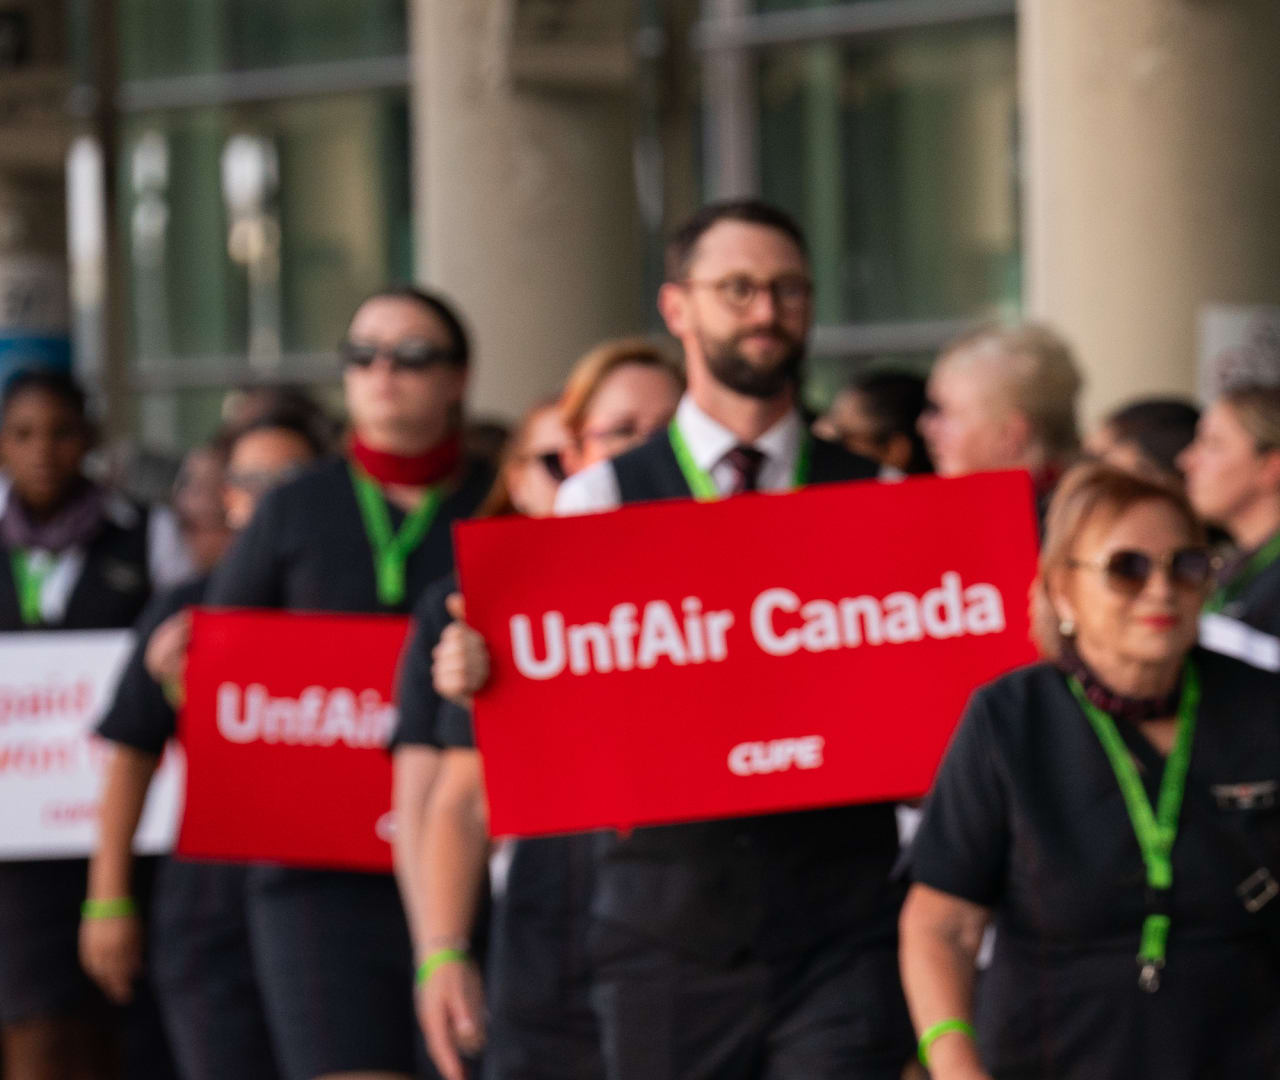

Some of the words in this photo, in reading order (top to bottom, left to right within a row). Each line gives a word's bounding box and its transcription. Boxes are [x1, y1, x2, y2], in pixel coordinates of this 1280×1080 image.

[511, 597, 733, 679] UnfAir
[752, 572, 1004, 655] Canada
[217, 681, 396, 748] UnfAir
[729, 736, 822, 775] CUPE
